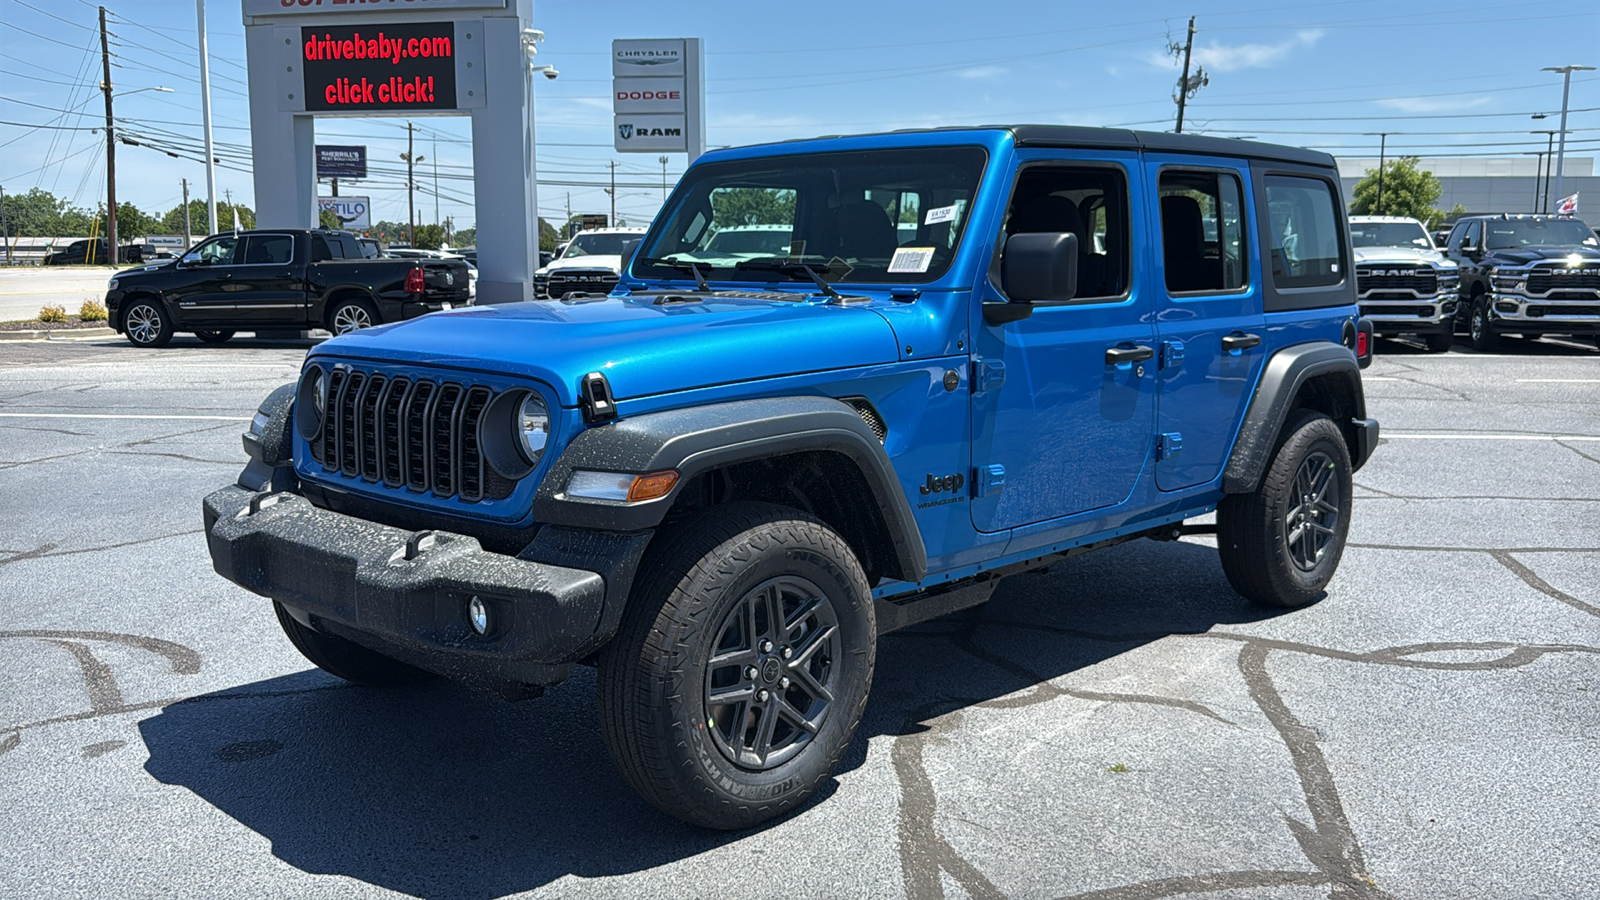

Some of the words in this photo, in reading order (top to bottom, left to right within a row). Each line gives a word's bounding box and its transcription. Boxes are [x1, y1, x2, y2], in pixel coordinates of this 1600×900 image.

[305, 32, 451, 64] drivebaby.com
[325, 78, 375, 104] click
[378, 76, 434, 103] click!
[617, 91, 680, 100] DODGE
[636, 128, 681, 137] RAM
[1371, 269, 1415, 277] RAM
[919, 472, 964, 495] Jeep
[917, 497, 957, 509] WRANGLER
